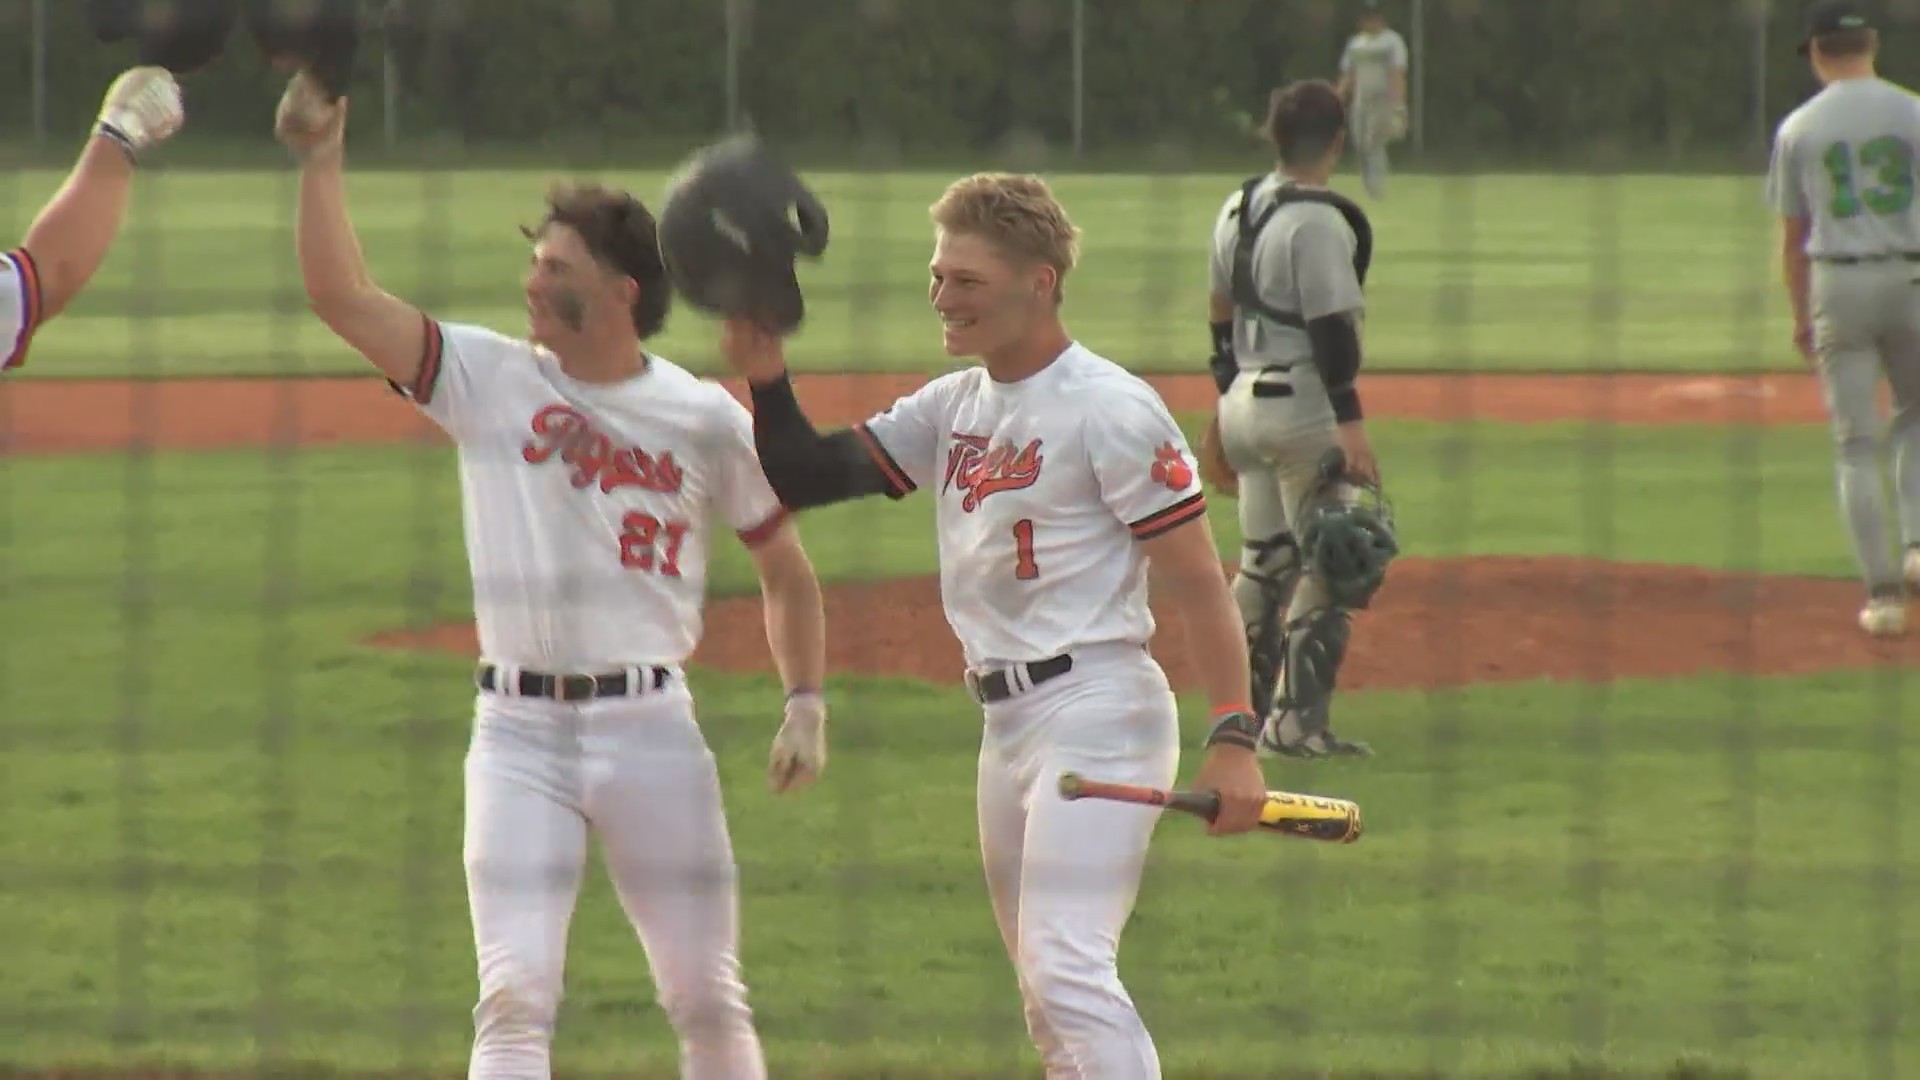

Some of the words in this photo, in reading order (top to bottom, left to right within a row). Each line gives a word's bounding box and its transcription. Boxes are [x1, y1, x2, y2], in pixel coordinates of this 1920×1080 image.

[1824, 134, 1914, 218] 13
[522, 404, 683, 494] Tigers
[619, 510, 690, 577] 21
[1013, 518, 1039, 580] 1
